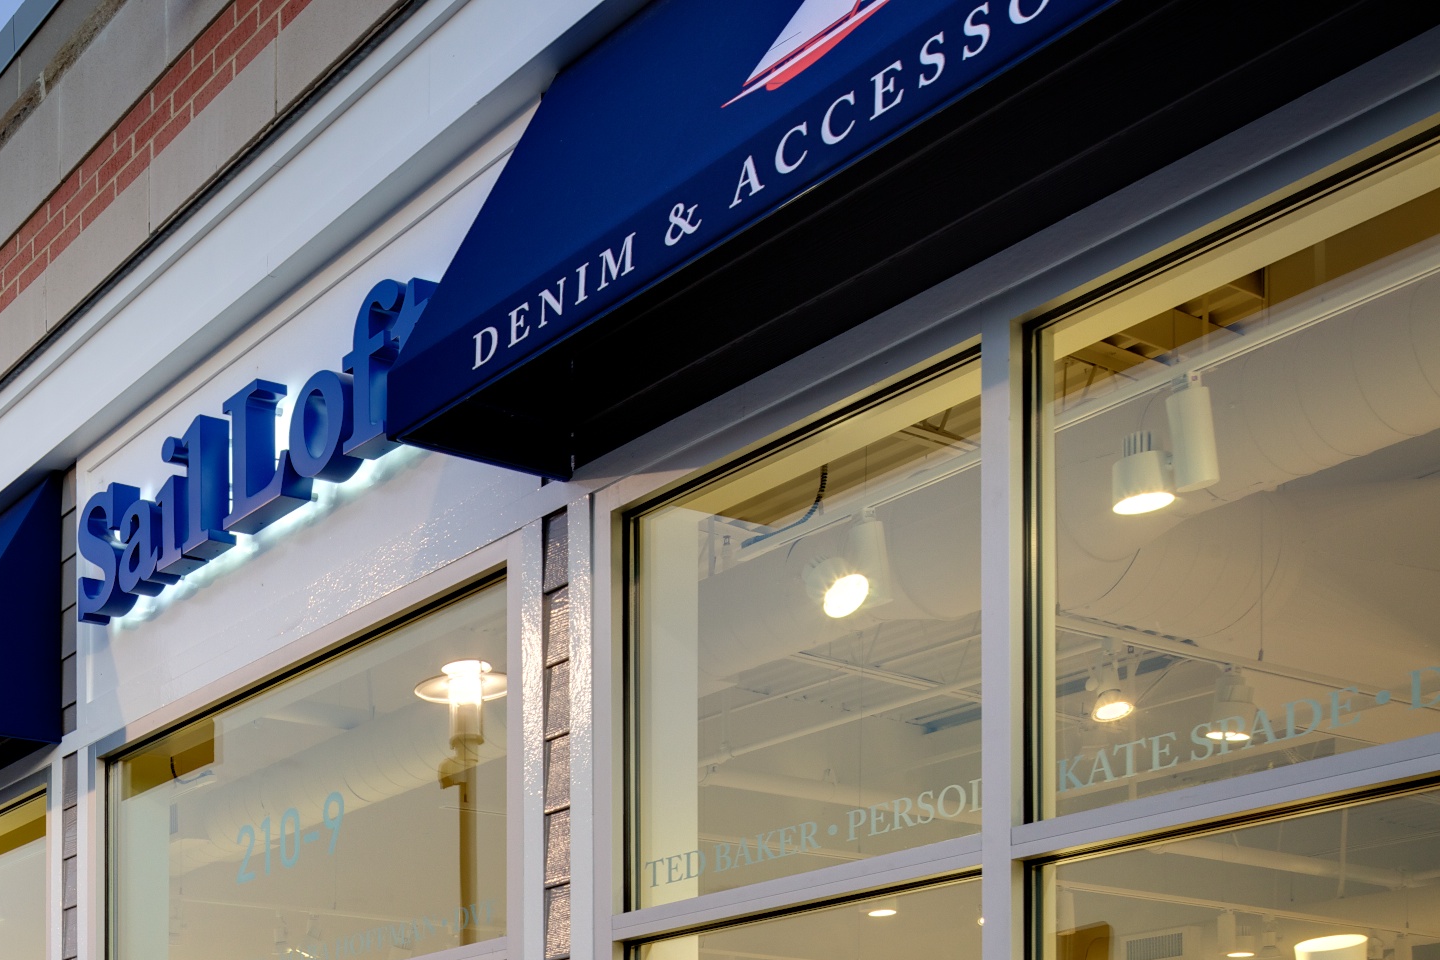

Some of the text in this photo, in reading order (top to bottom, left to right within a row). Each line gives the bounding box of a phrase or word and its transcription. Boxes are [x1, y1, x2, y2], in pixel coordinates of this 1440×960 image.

[471, 231, 637, 371] DENIM
[663, 202, 703, 247] &
[1056, 731, 1179, 793] KATE
[1190, 686, 1360, 763] SPADE
[235, 790, 346, 885] 210-9
[644, 849, 707, 889] TED
[712, 820, 822, 874] BAKER
